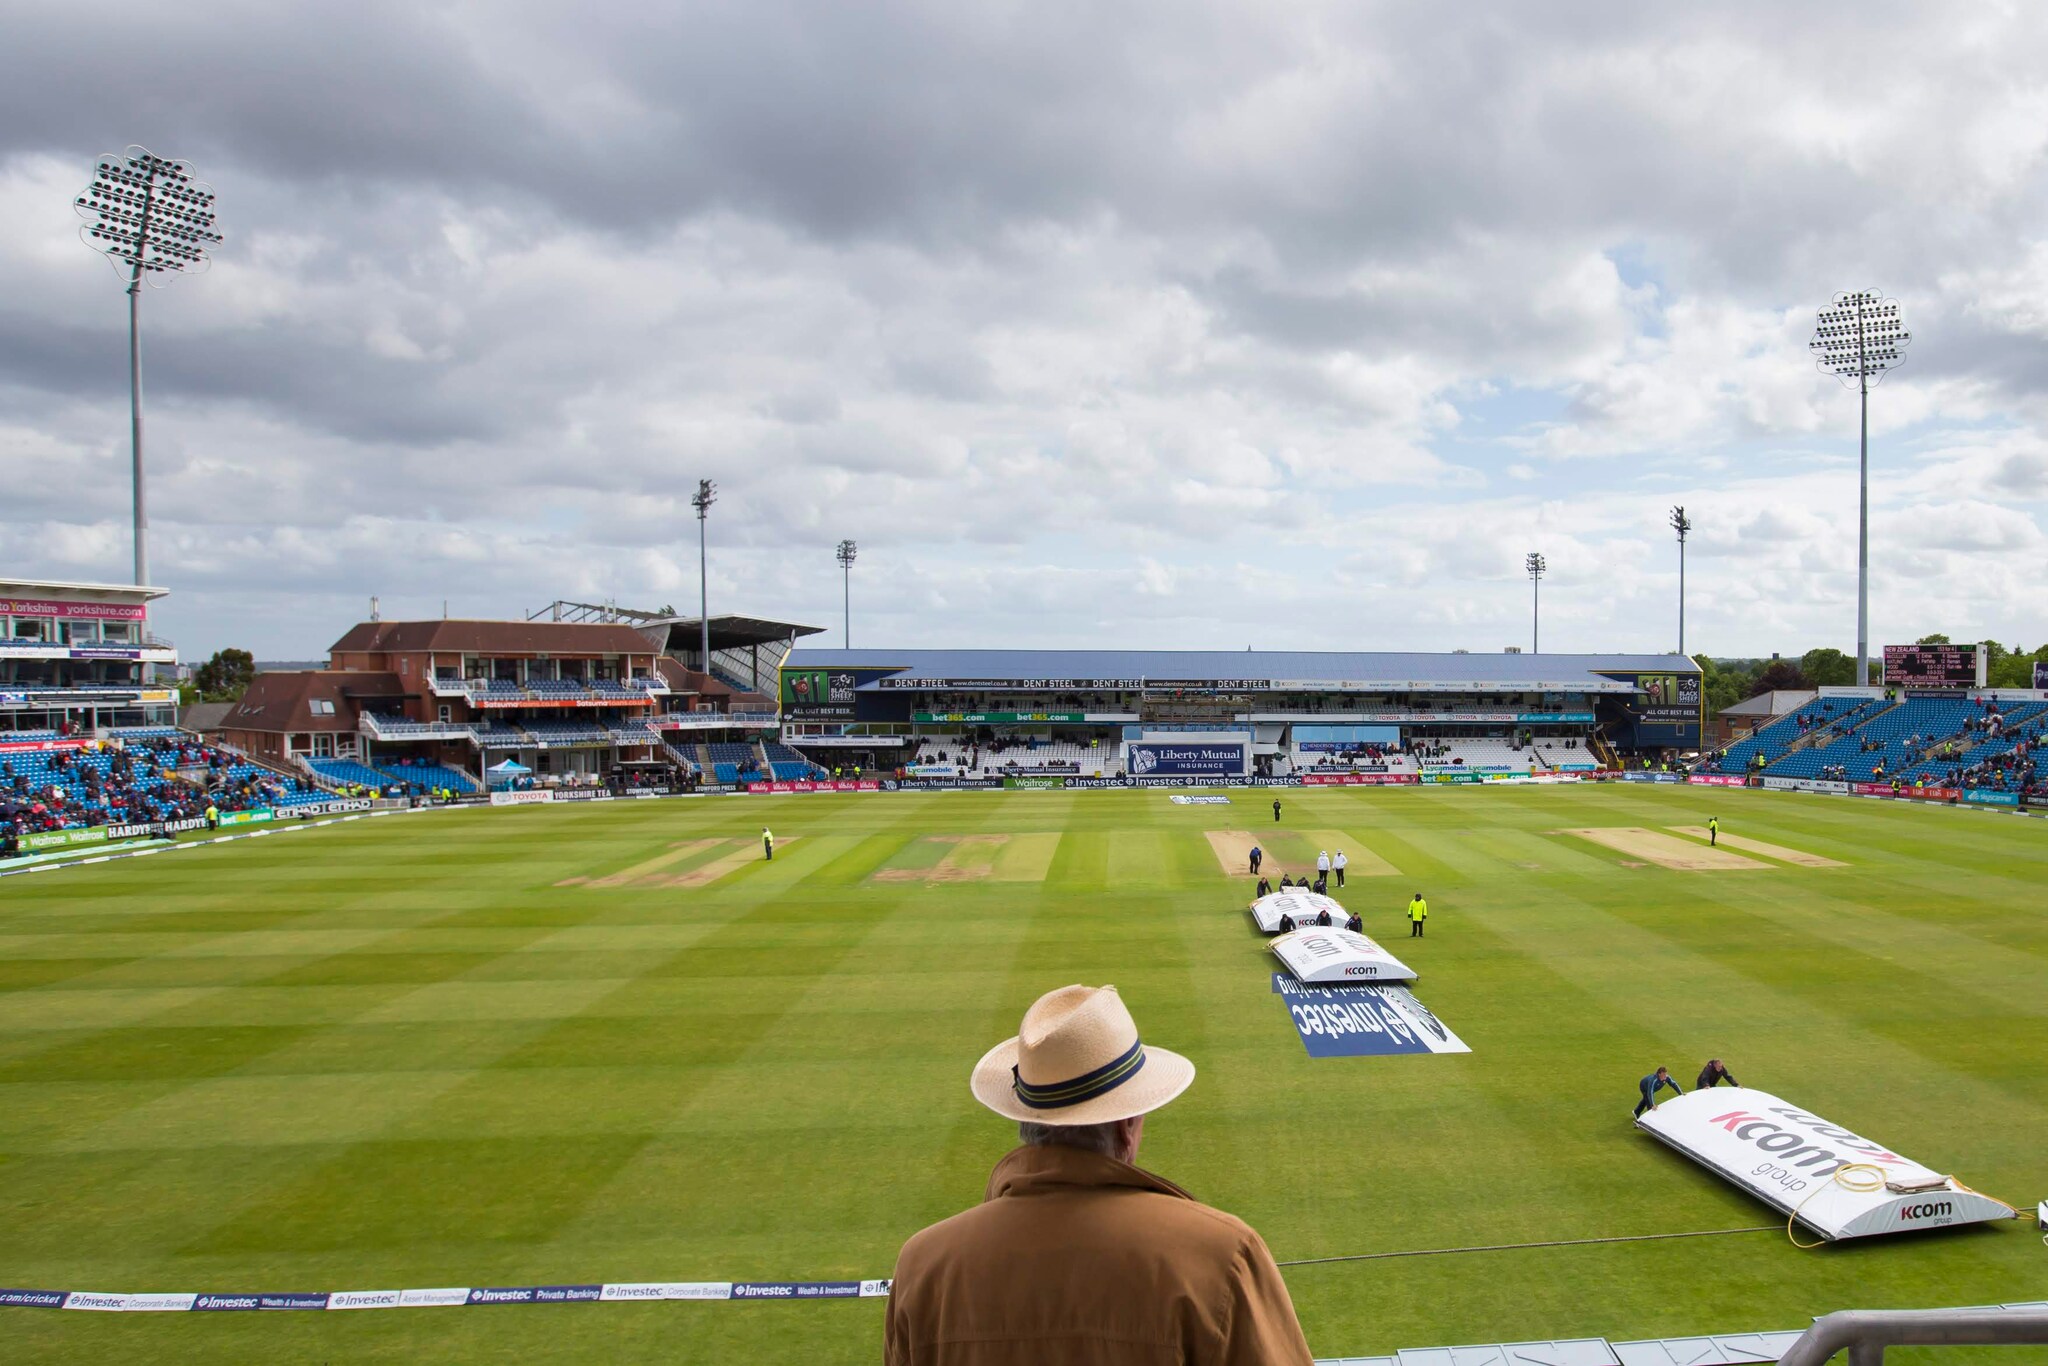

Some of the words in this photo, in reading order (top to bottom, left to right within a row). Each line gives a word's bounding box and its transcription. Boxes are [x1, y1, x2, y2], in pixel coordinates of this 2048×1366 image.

[10, 602, 58, 614] Yorkshire
[66, 604, 142, 617] yorkshire.com
[895, 679, 918, 687] DENT
[921, 679, 948, 687] STEEL
[1023, 679, 1046, 687] DENT
[1049, 679, 1075, 687] STEEL
[1093, 680, 1116, 688] DENT
[1118, 680, 1144, 688] STEEL
[1217, 680, 1240, 688] DENT
[1242, 680, 1269, 688] STEEL
[932, 713, 985, 721] bet365.com
[1017, 713, 1069, 721] bet365.com
[1160, 750, 1199, 762] Liberty
[1200, 749, 1240, 760] Mutual
[907, 767, 952, 775] Lycamobile
[1592, 771, 1623, 779] Pedigree
[1075, 778, 1124, 787] Investec
[1136, 777, 1184, 786] Investec
[1195, 777, 1242, 785] Investec
[1254, 777, 1302, 785] Investec
[1421, 774, 1472, 782] bet365.com
[901, 780, 927, 788] Liberty
[1015, 779, 1053, 787] Waitrose
[512, 792, 548, 800] TOYOTA
[554, 790, 596, 799] YORKSHIRE
[597, 789, 612, 798] TEA
[328, 801, 371, 812] ETIHAD
[108, 823, 151, 838] HARDYS
[30, 835, 66, 847] Waitrose
[69, 829, 105, 842] Waitrose
[1292, 1003, 1402, 1045] Investec
[1751, 1161, 1807, 1192] group
[1933, 1216, 1953, 1226] group
[79, 1295, 125, 1308] Investec
[129, 1298, 163, 1308] Corporate
[164, 1299, 191, 1309] Banking
[208, 1296, 258, 1308] Investec
[261, 1297, 283, 1306] Wealth
[284, 1298, 290, 1306] &
[290, 1298, 326, 1307] Investment
[344, 1294, 395, 1306] Investec
[403, 1294, 422, 1303] Asset
[423, 1293, 466, 1304] Management
[482, 1289, 532, 1301] Investec
[536, 1290, 565, 1299] Private
[566, 1289, 600, 1300] Banking
[615, 1286, 663, 1297] Investec
[667, 1287, 701, 1297] Corporate
[702, 1286, 729, 1297] Banking
[745, 1284, 792, 1296] Investec
[797, 1286, 818, 1294] Wealth
[825, 1286, 858, 1295] Investment
